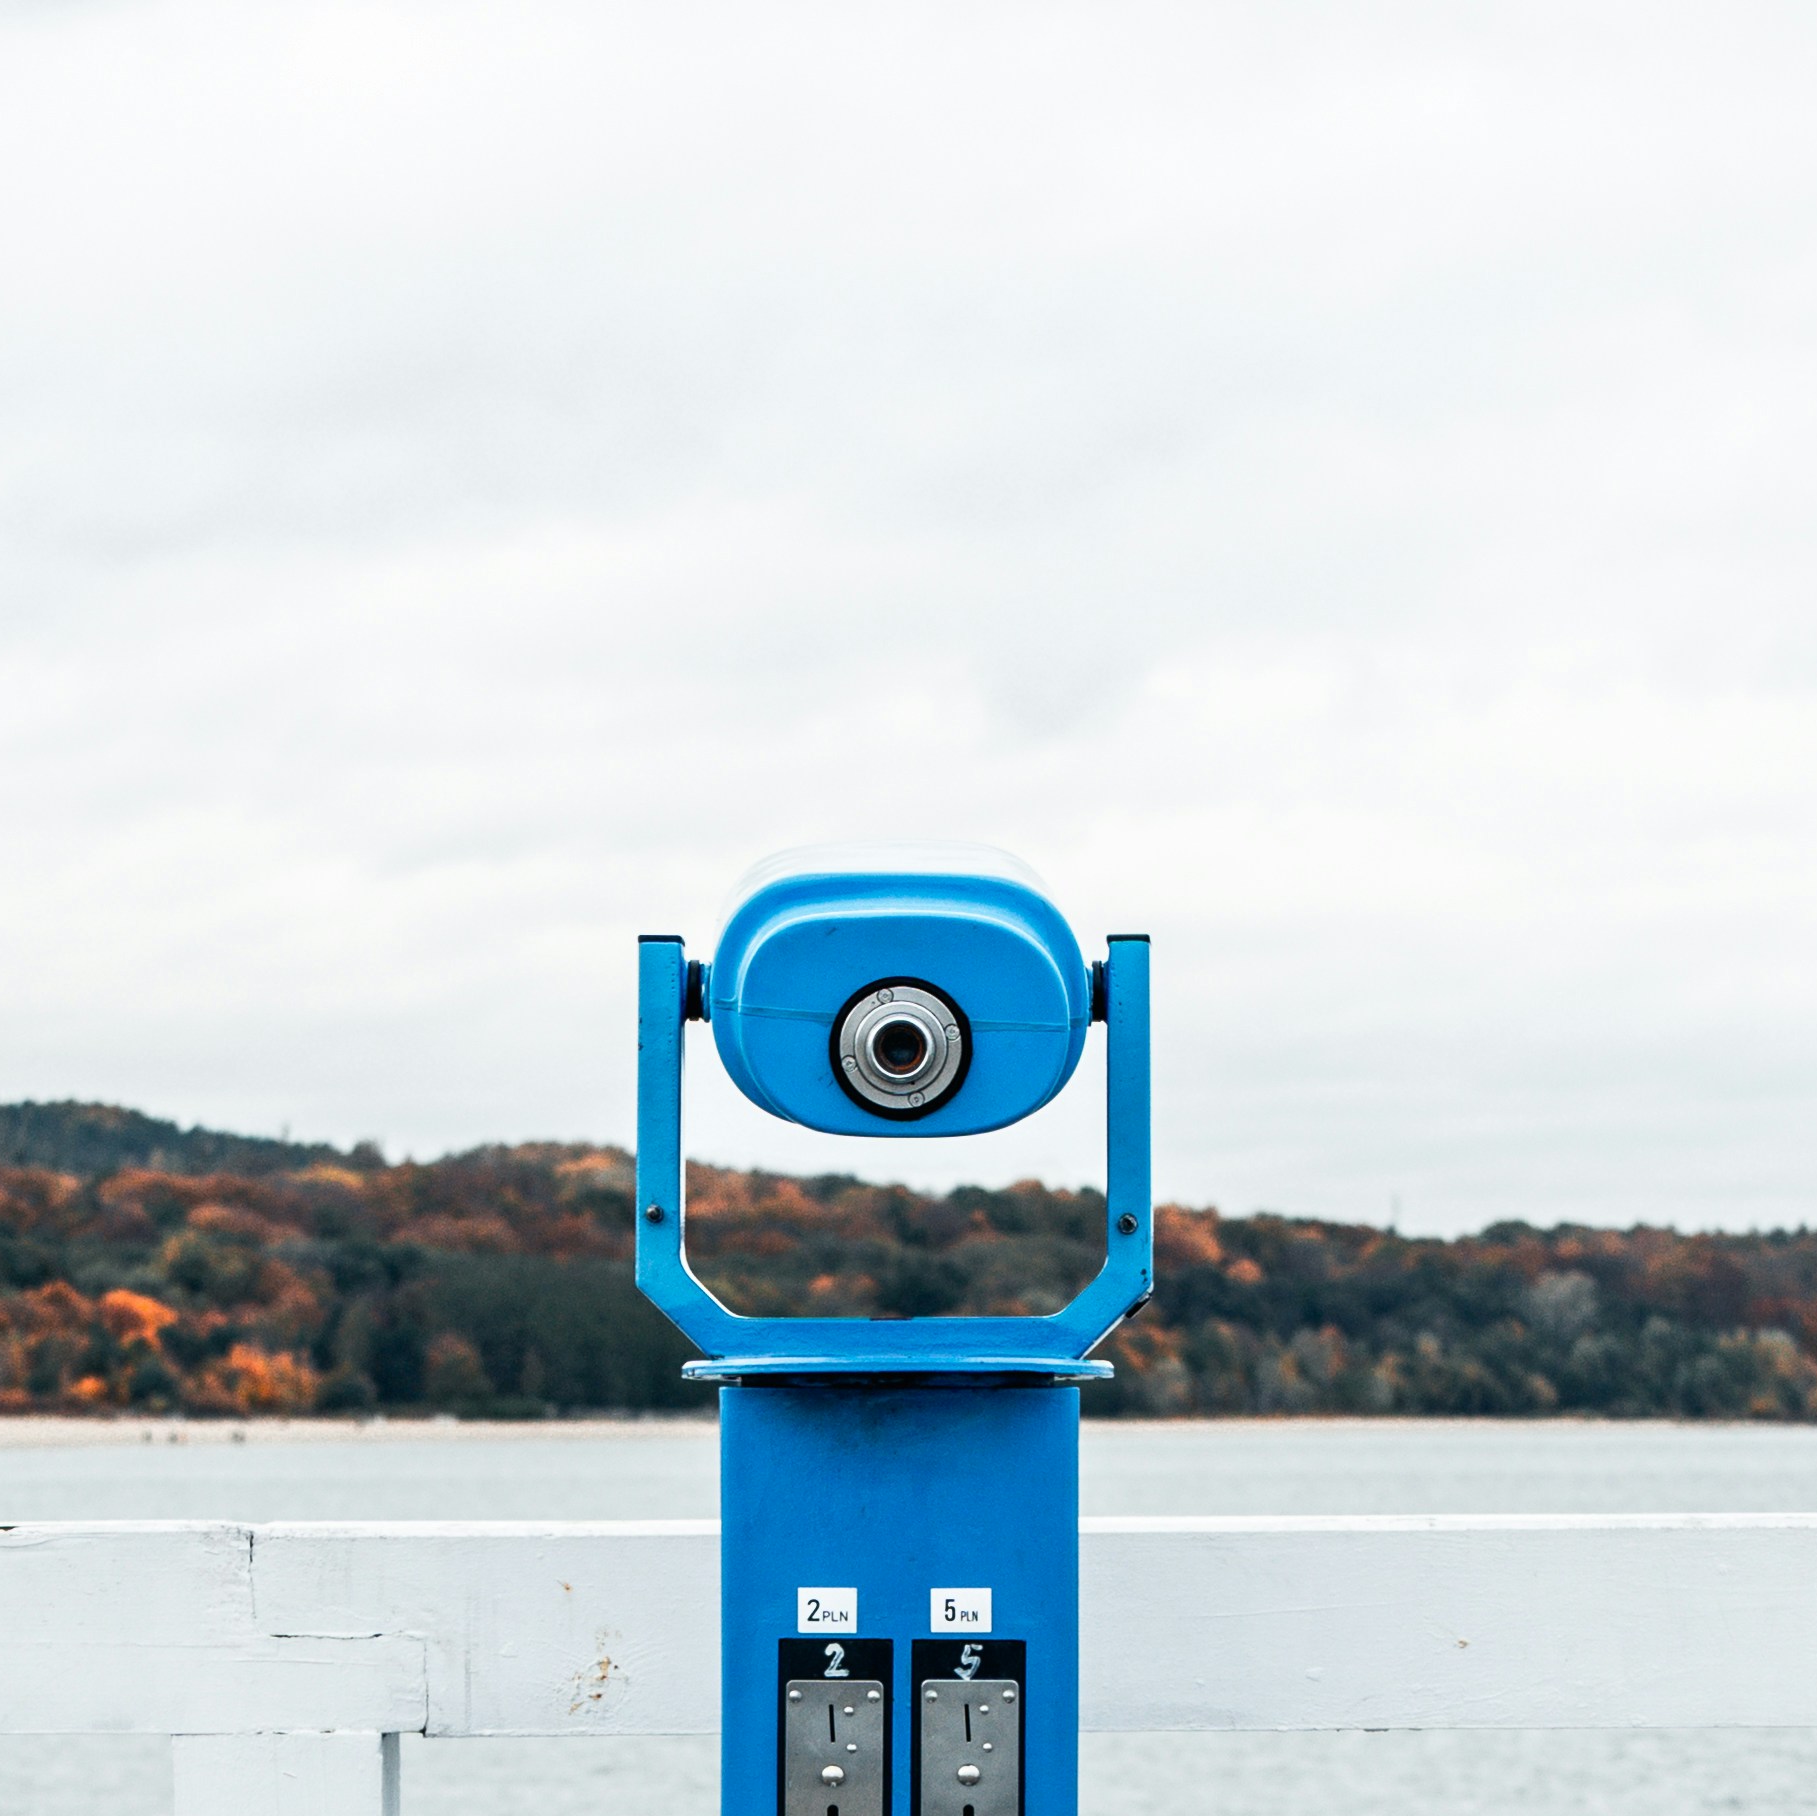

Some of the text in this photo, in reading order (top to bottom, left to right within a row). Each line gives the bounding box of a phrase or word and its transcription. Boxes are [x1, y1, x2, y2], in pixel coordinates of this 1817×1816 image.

[806, 1599, 849, 1622] 2 PLN
[944, 1599, 979, 1622] 5 PLN
[824, 1643, 849, 1677] 2
[954, 1644, 983, 1680] 5
